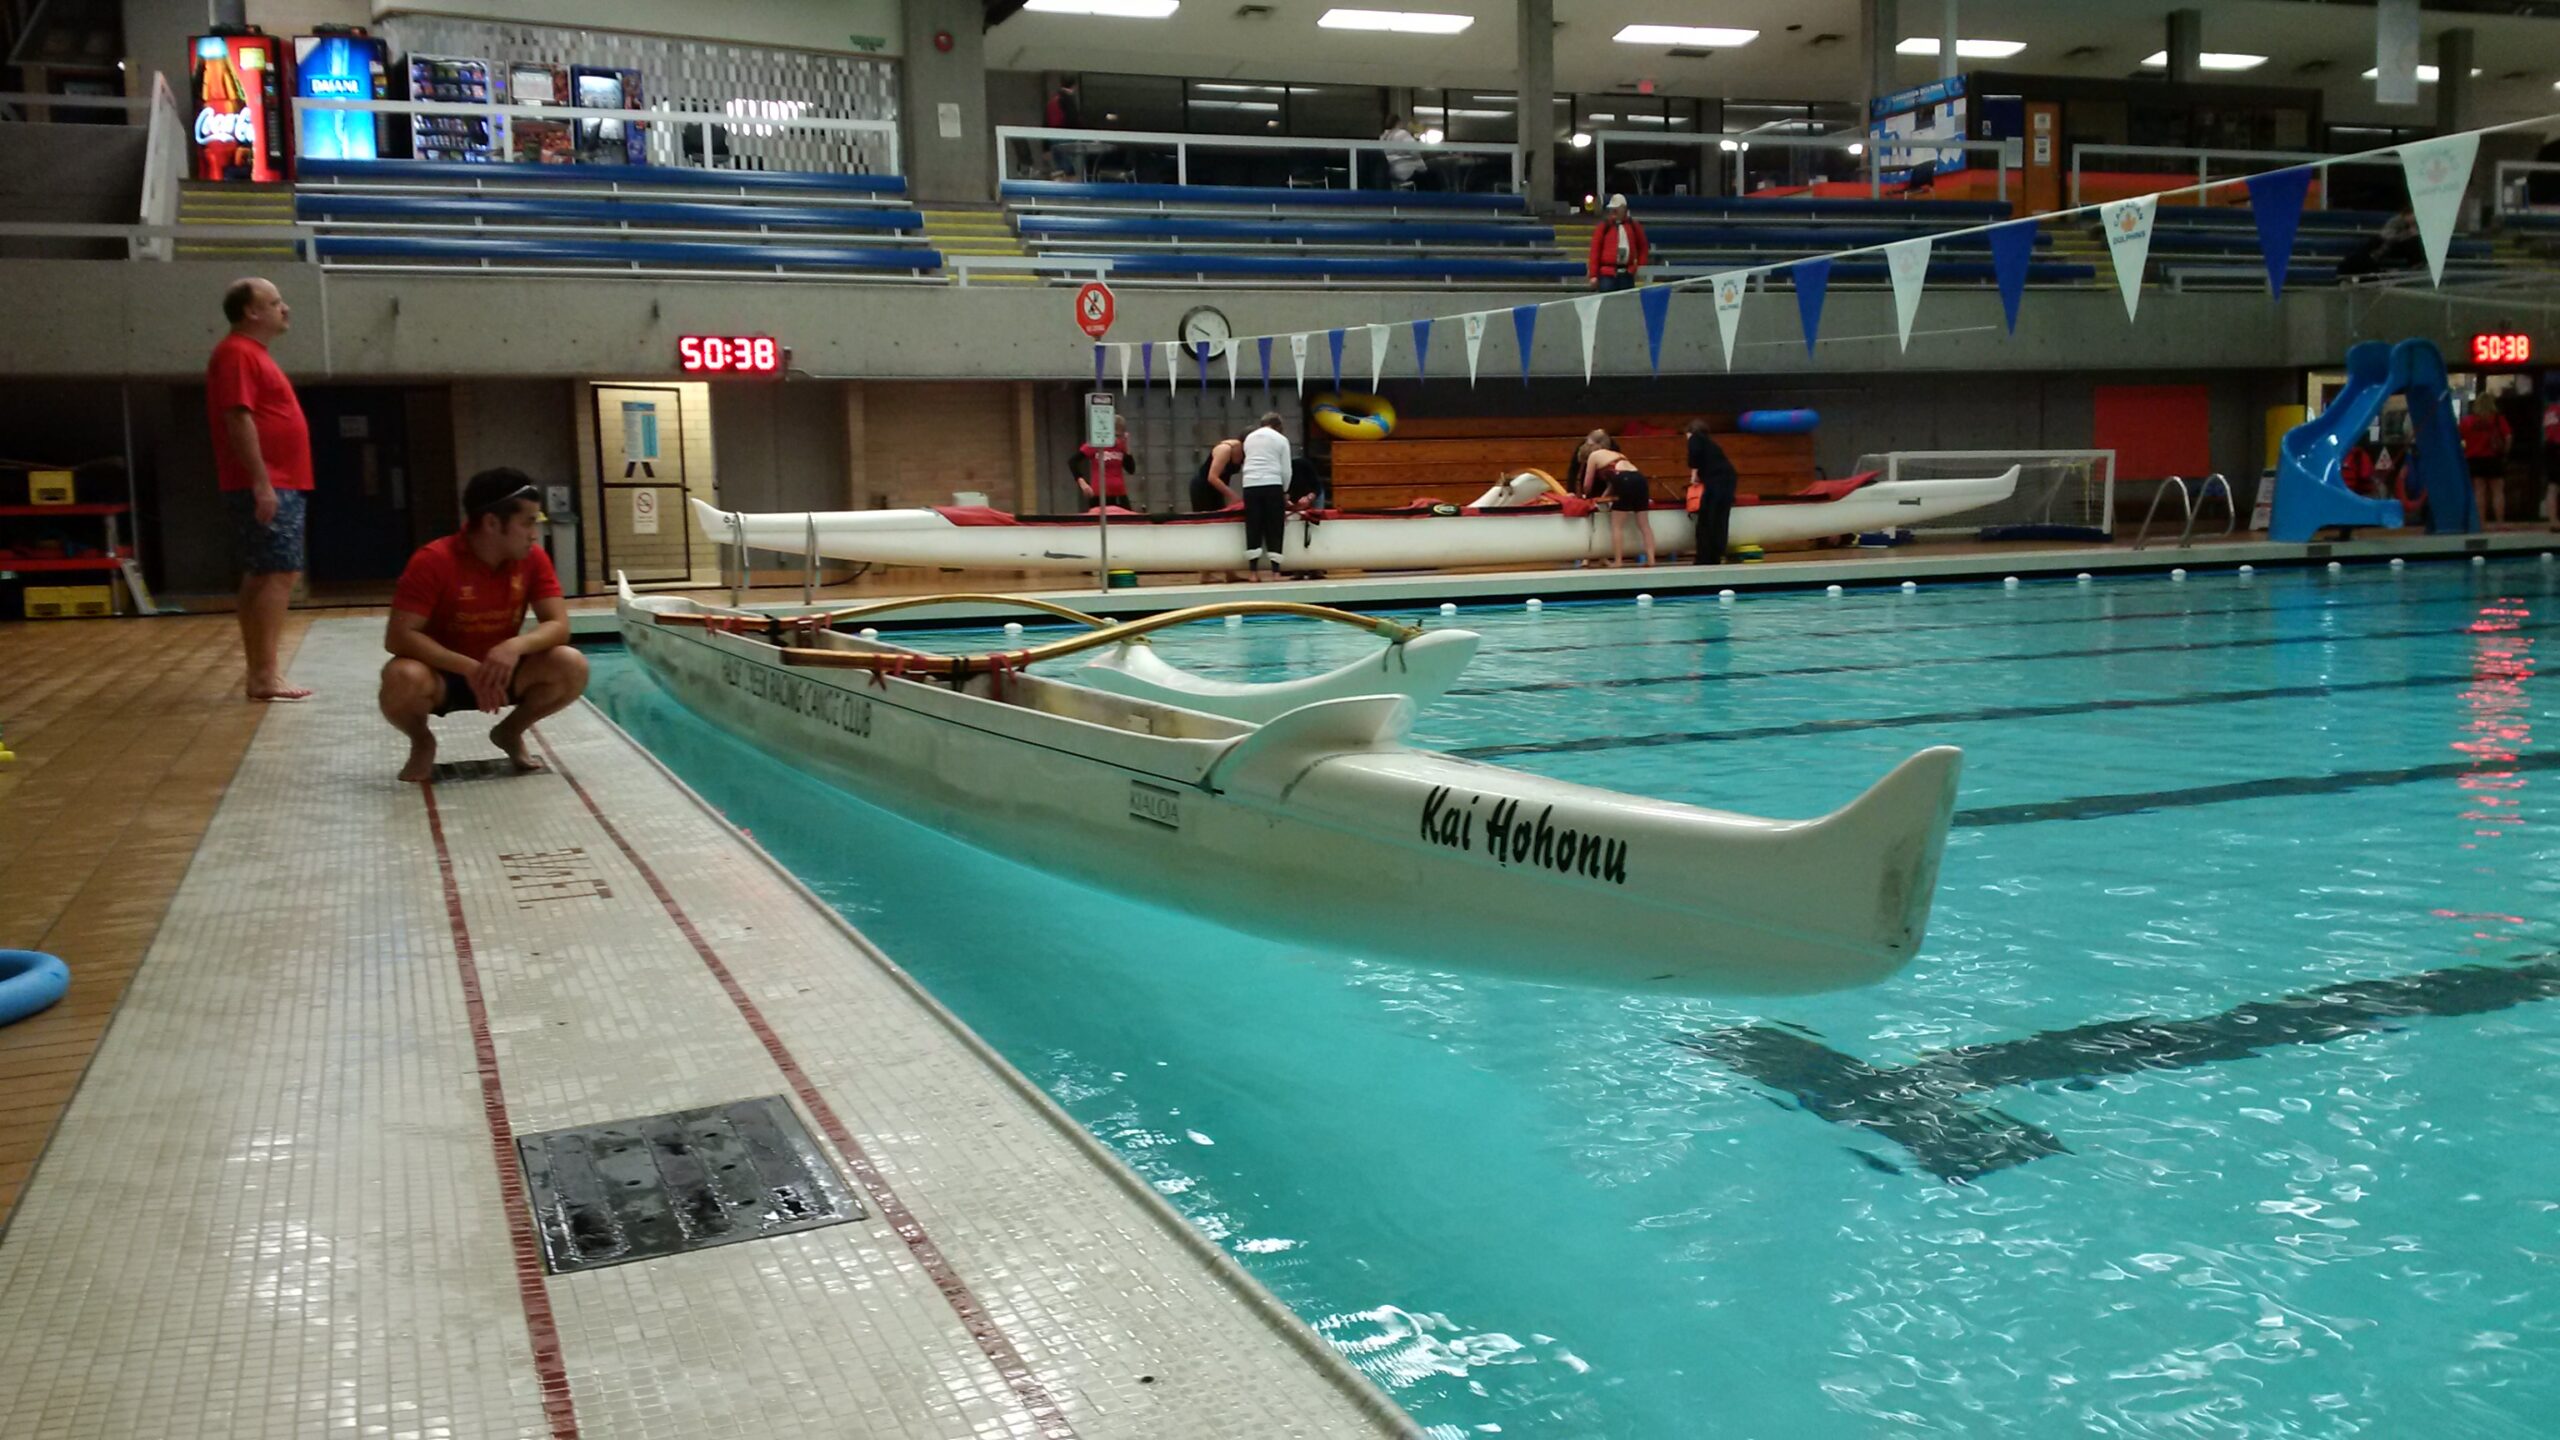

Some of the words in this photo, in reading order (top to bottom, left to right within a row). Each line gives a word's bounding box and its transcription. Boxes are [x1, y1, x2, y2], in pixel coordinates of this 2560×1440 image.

[680, 337, 775, 370] 50:38
[2474, 334, 2529, 361] 50:38
[841, 692, 872, 739] CLUB
[1421, 785, 1480, 851] Kai
[1486, 797, 1627, 885] Hohonu
